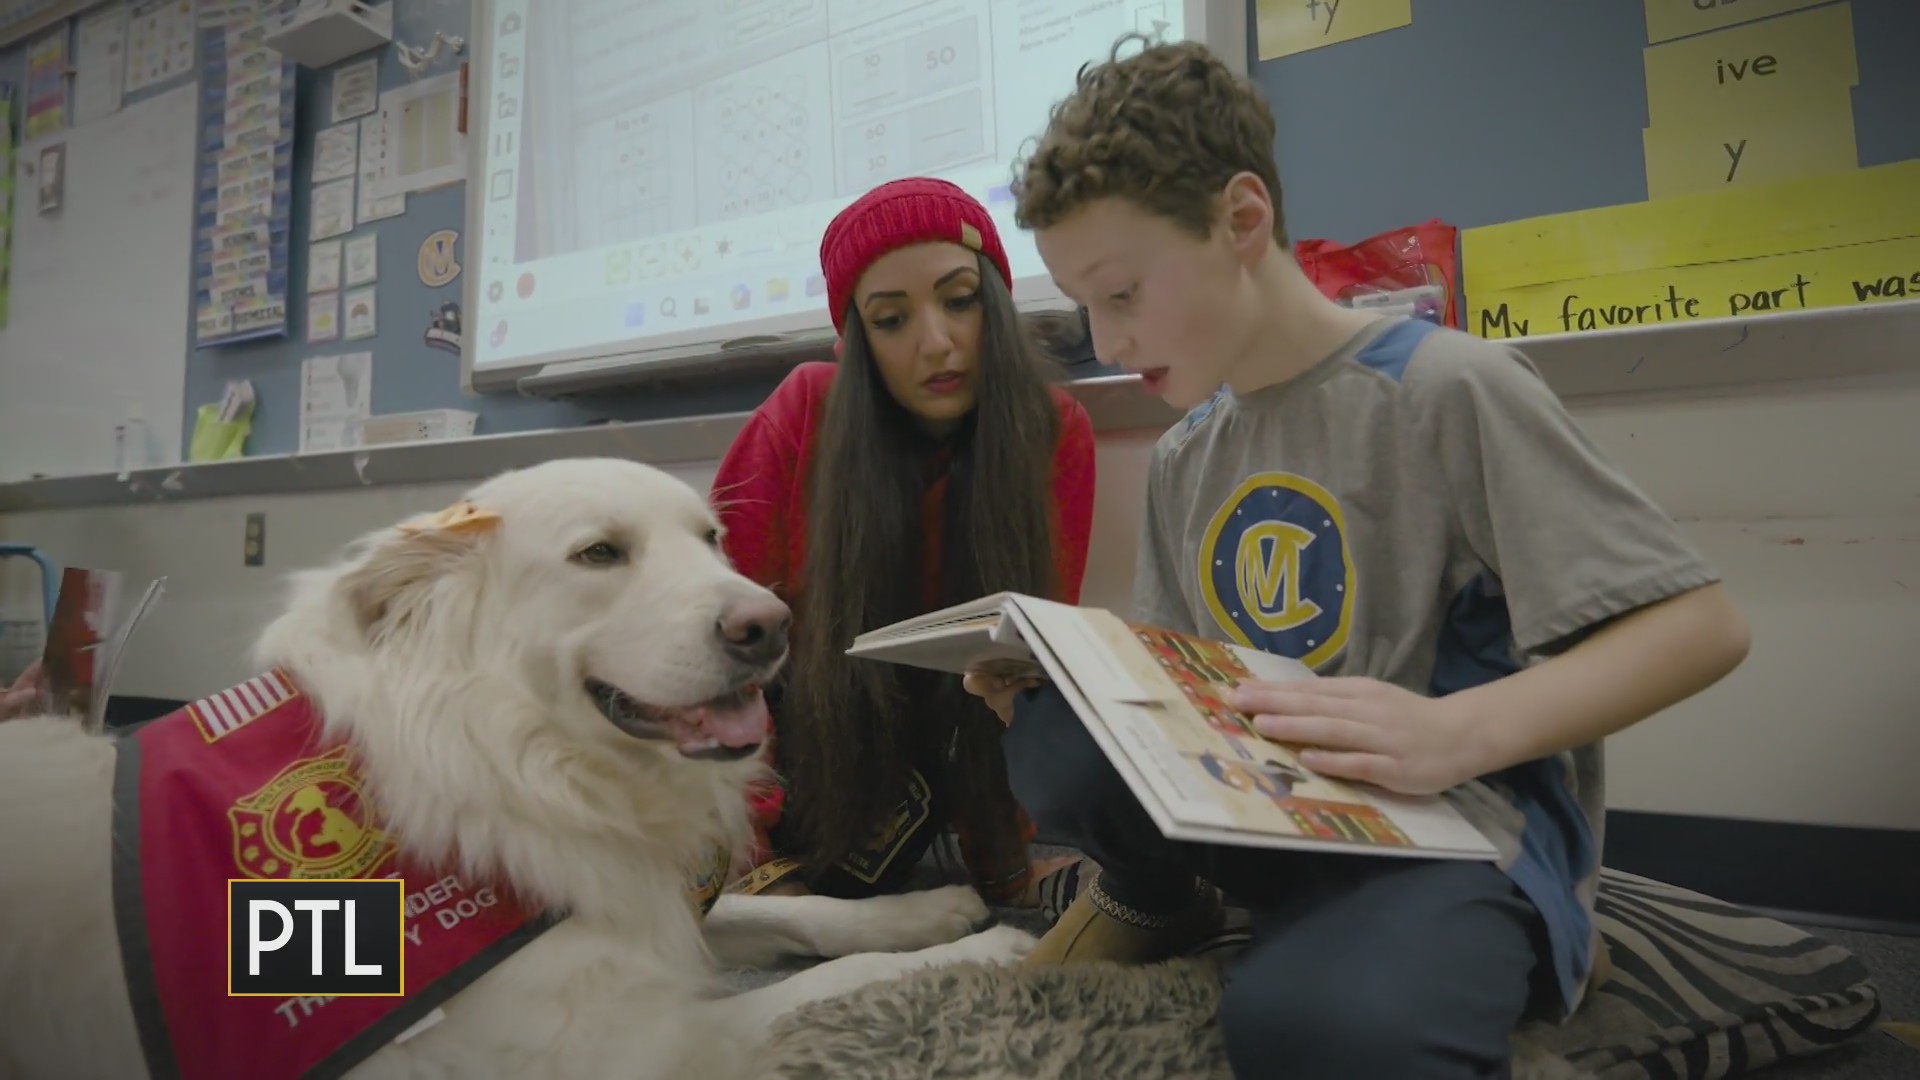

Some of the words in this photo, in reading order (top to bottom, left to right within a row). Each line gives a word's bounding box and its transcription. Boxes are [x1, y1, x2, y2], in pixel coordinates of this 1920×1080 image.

[926, 45, 956, 70] 50
[1716, 55, 1778, 85] ive
[1723, 139, 1747, 182] y
[1557, 284, 1700, 332] favorite
[1729, 273, 1811, 317] part
[1851, 271, 1920, 302] was
[434, 887, 499, 930] DOG
